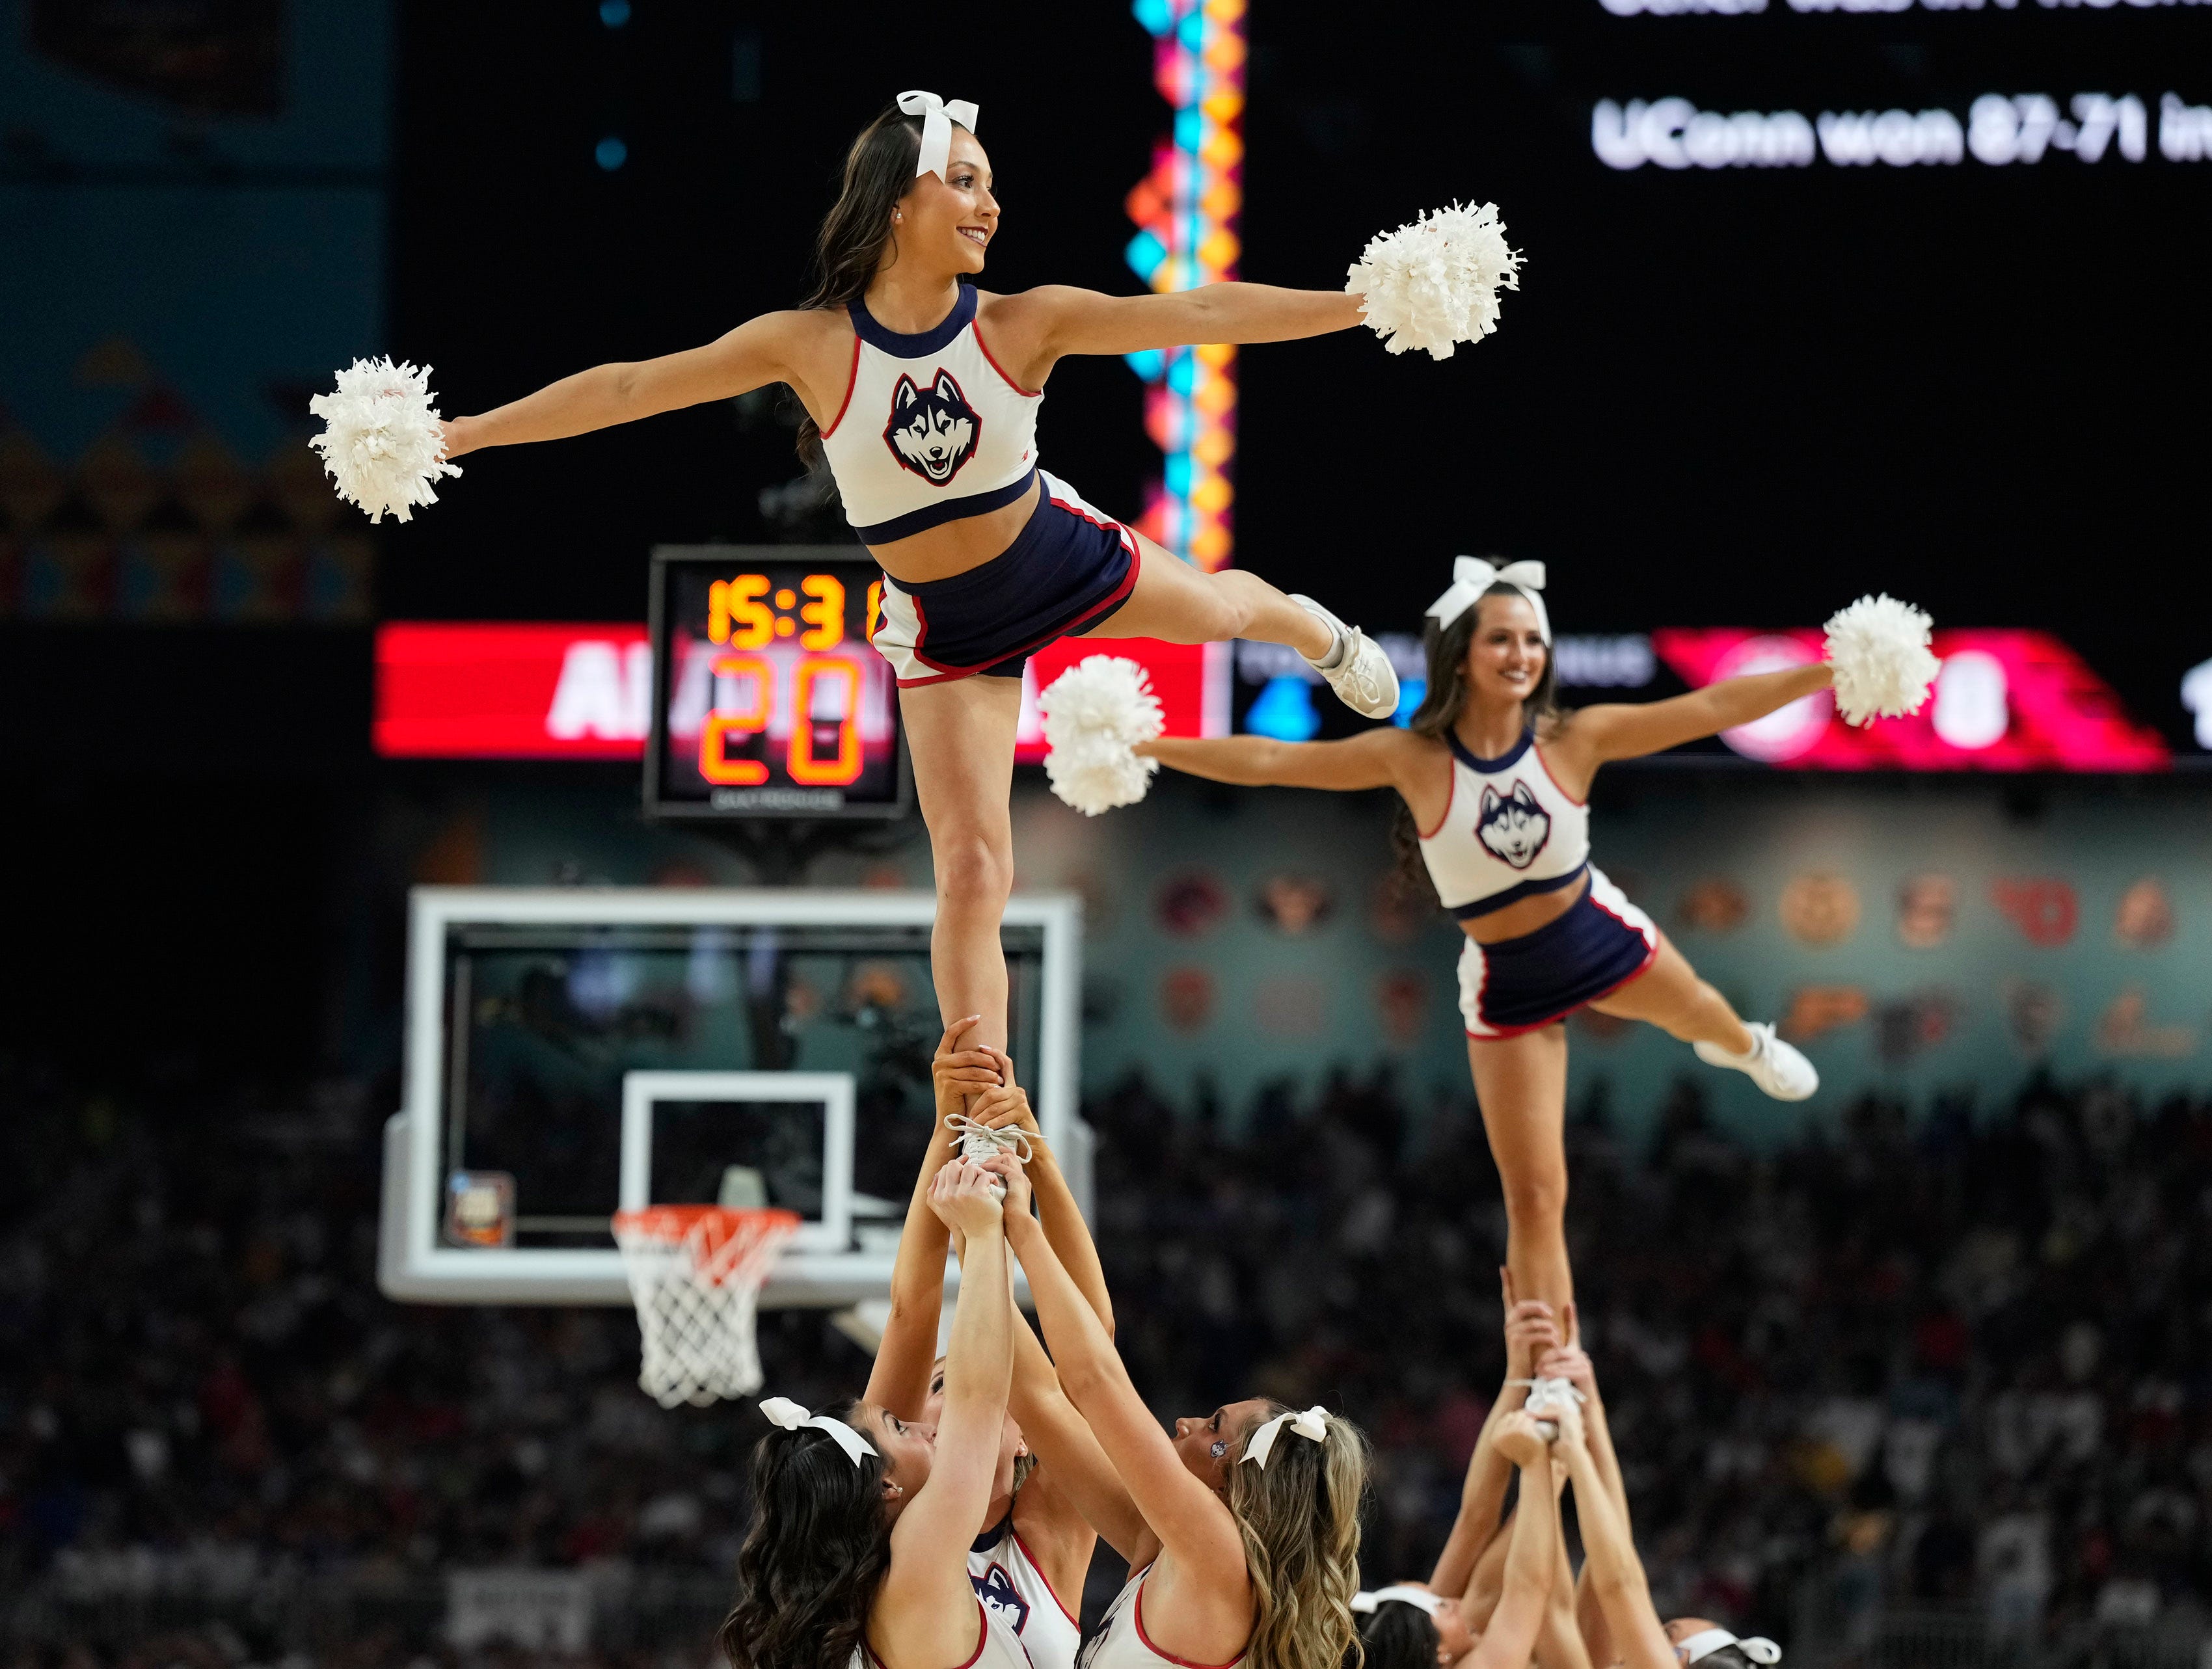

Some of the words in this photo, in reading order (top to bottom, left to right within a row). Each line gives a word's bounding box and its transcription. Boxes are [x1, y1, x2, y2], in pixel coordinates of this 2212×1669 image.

[1591, 97, 1816, 169] UConn
[1816, 109, 1963, 166] won
[1967, 93, 2147, 165] 87-71
[708, 574, 882, 651] 15:3
[698, 653, 866, 786] 20
